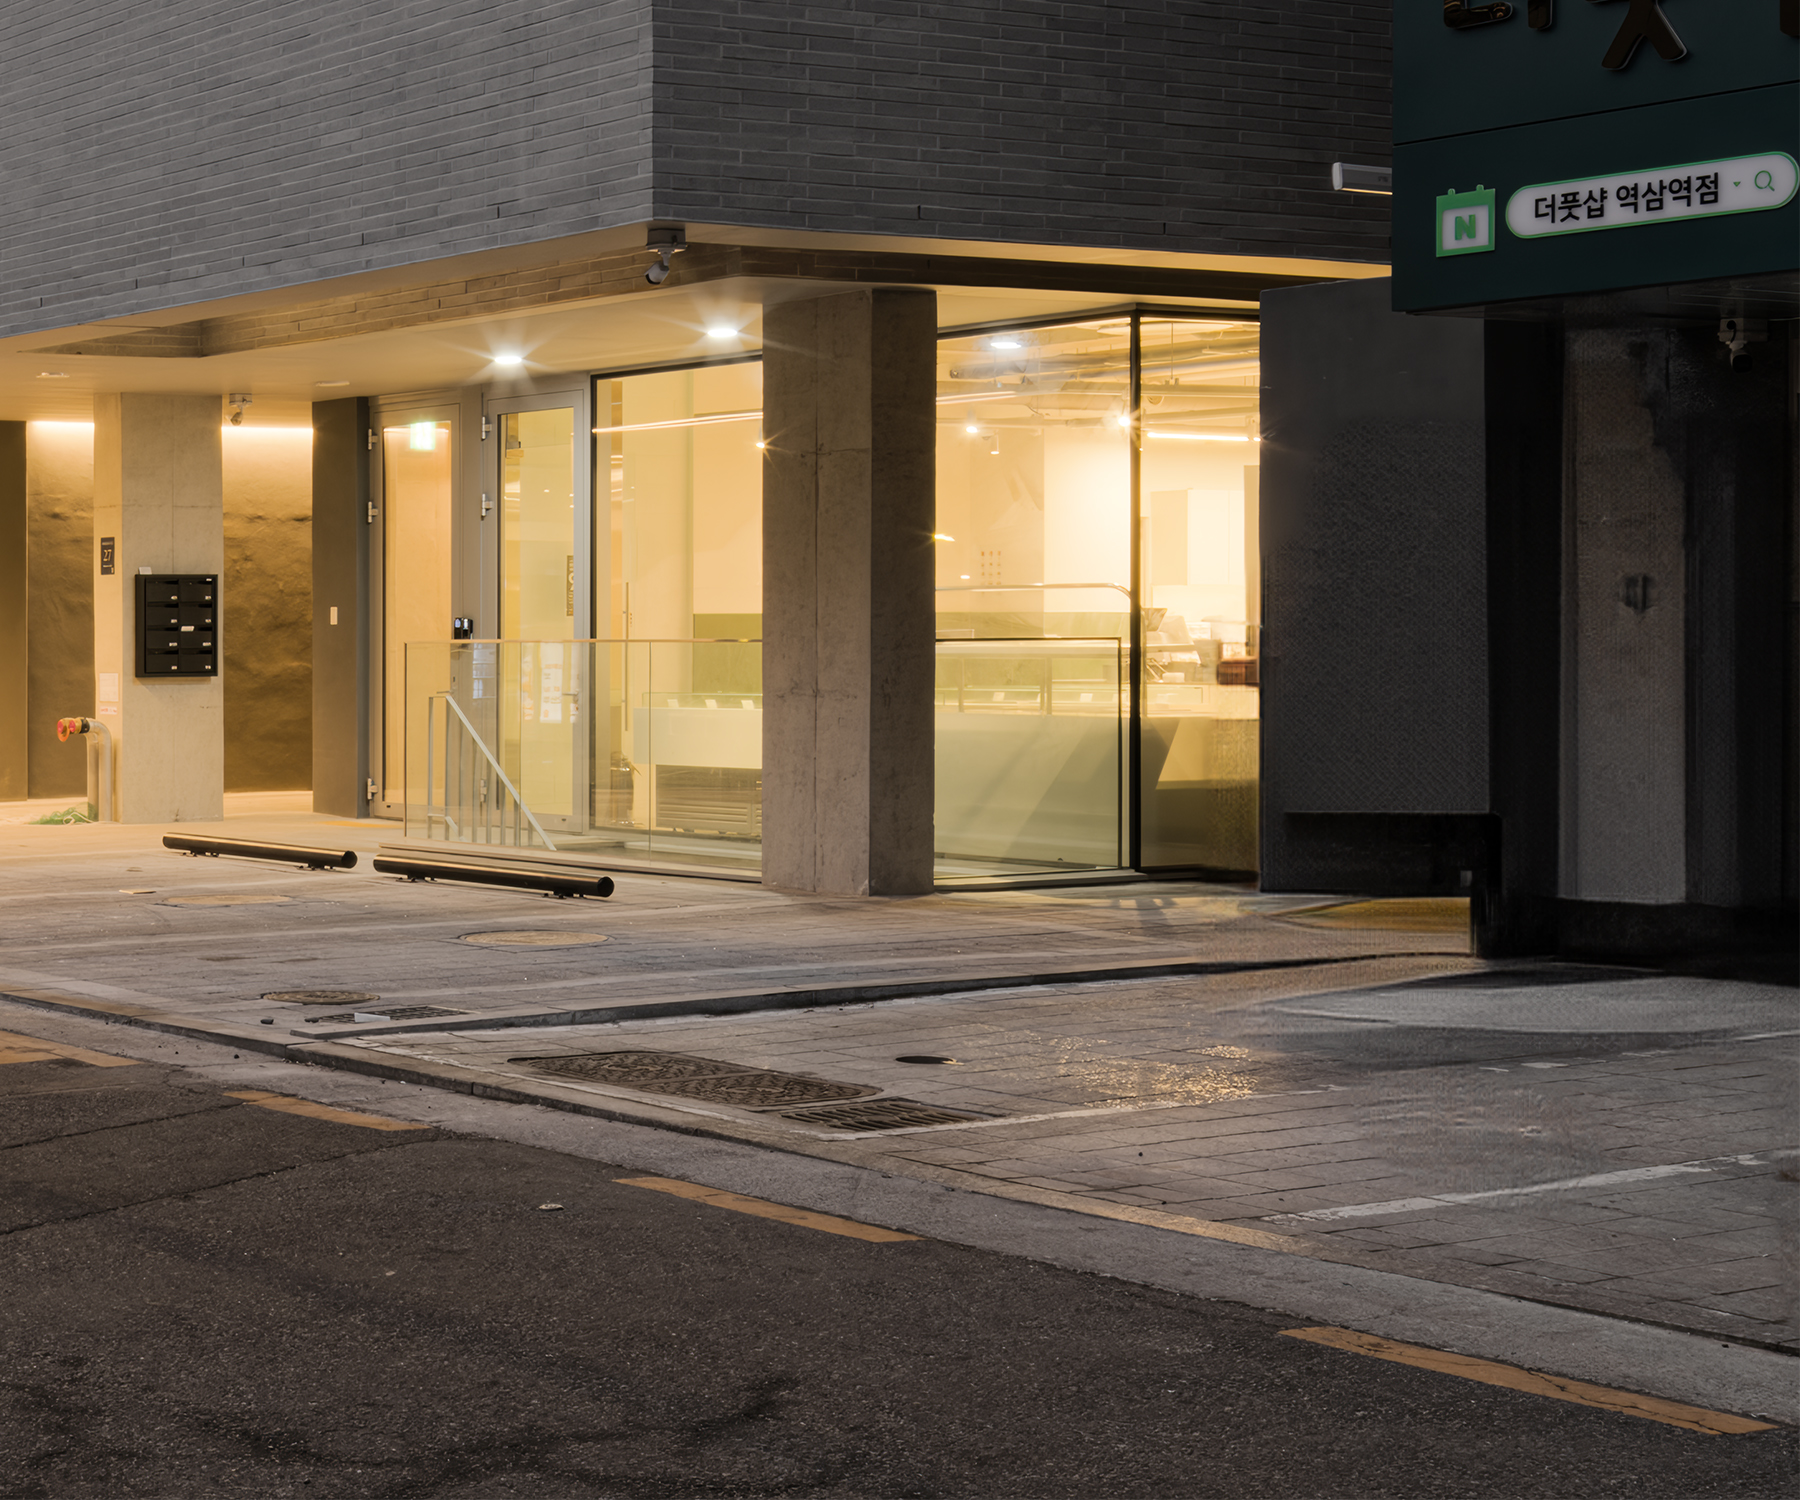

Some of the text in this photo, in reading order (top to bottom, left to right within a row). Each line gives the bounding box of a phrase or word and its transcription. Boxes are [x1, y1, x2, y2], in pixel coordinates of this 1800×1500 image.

[1534, 172, 1719, 224] 더풋샵 역삼역점
[1454, 214, 1477, 241] N
[103, 549, 112, 562] 27
